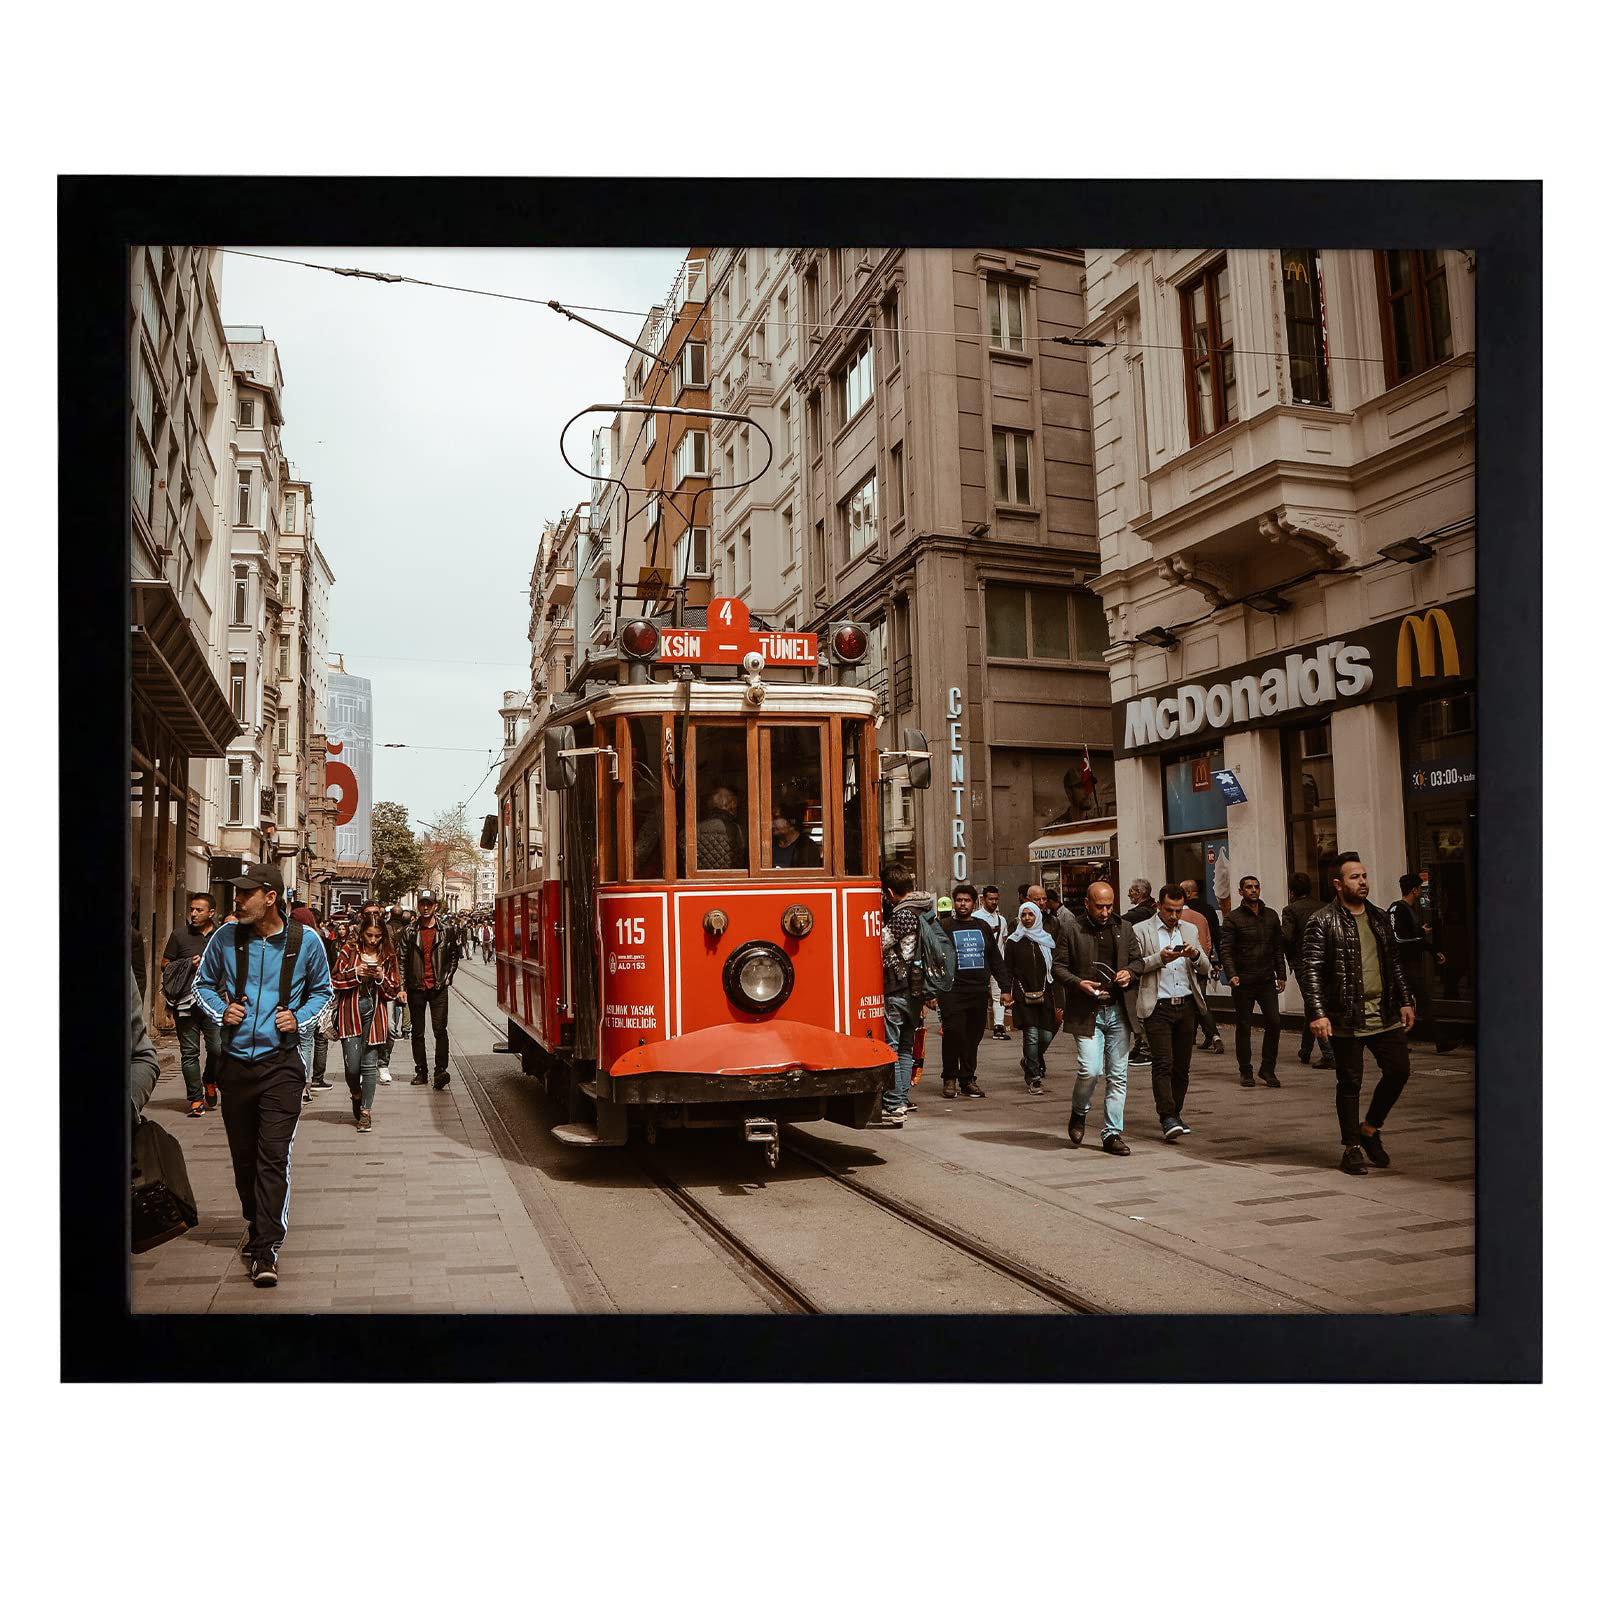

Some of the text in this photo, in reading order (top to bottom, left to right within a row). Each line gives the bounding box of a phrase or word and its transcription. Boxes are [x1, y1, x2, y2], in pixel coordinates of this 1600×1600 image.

[720, 600, 733, 626] 4
[661, 632, 701, 658] KSİM
[759, 635, 815, 660] TÜNEL
[1124, 641, 1374, 750] McDonald's
[1057, 846, 1085, 858] GAZETE
[616, 917, 646, 945] 115
[862, 910, 881, 937] 115
[632, 962, 646, 970] 153
[630, 1005, 655, 1016] YASAK
[857, 1008, 867, 1020] VE
